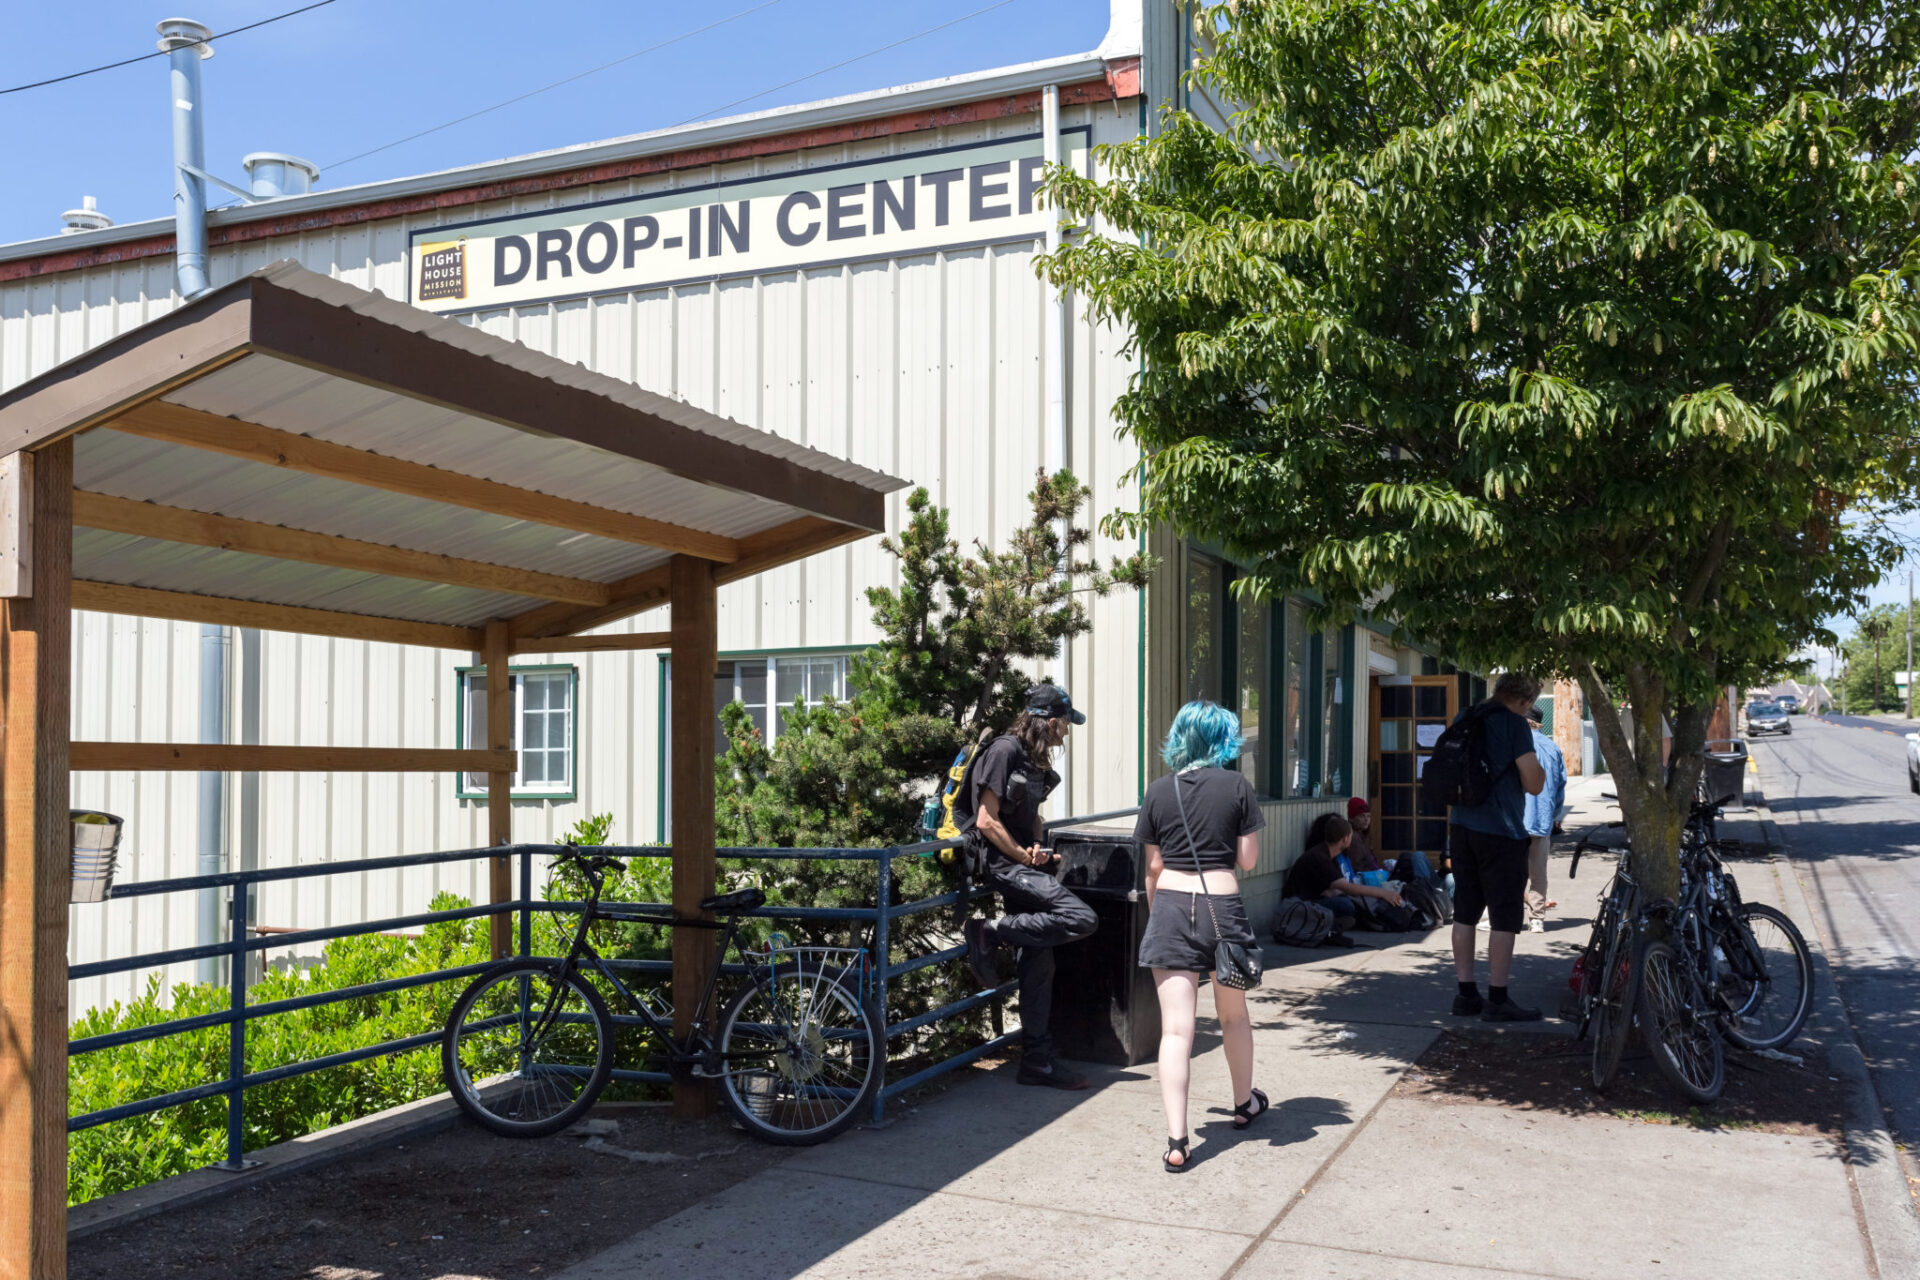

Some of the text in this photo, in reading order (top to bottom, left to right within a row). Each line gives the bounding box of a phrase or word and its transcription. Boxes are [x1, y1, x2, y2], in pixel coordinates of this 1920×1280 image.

[494, 200, 750, 287] DROP-IN
[425, 252, 462, 267] LIGHT
[425, 267, 462, 280] HOUSE
[424, 279, 462, 290] MISSION
